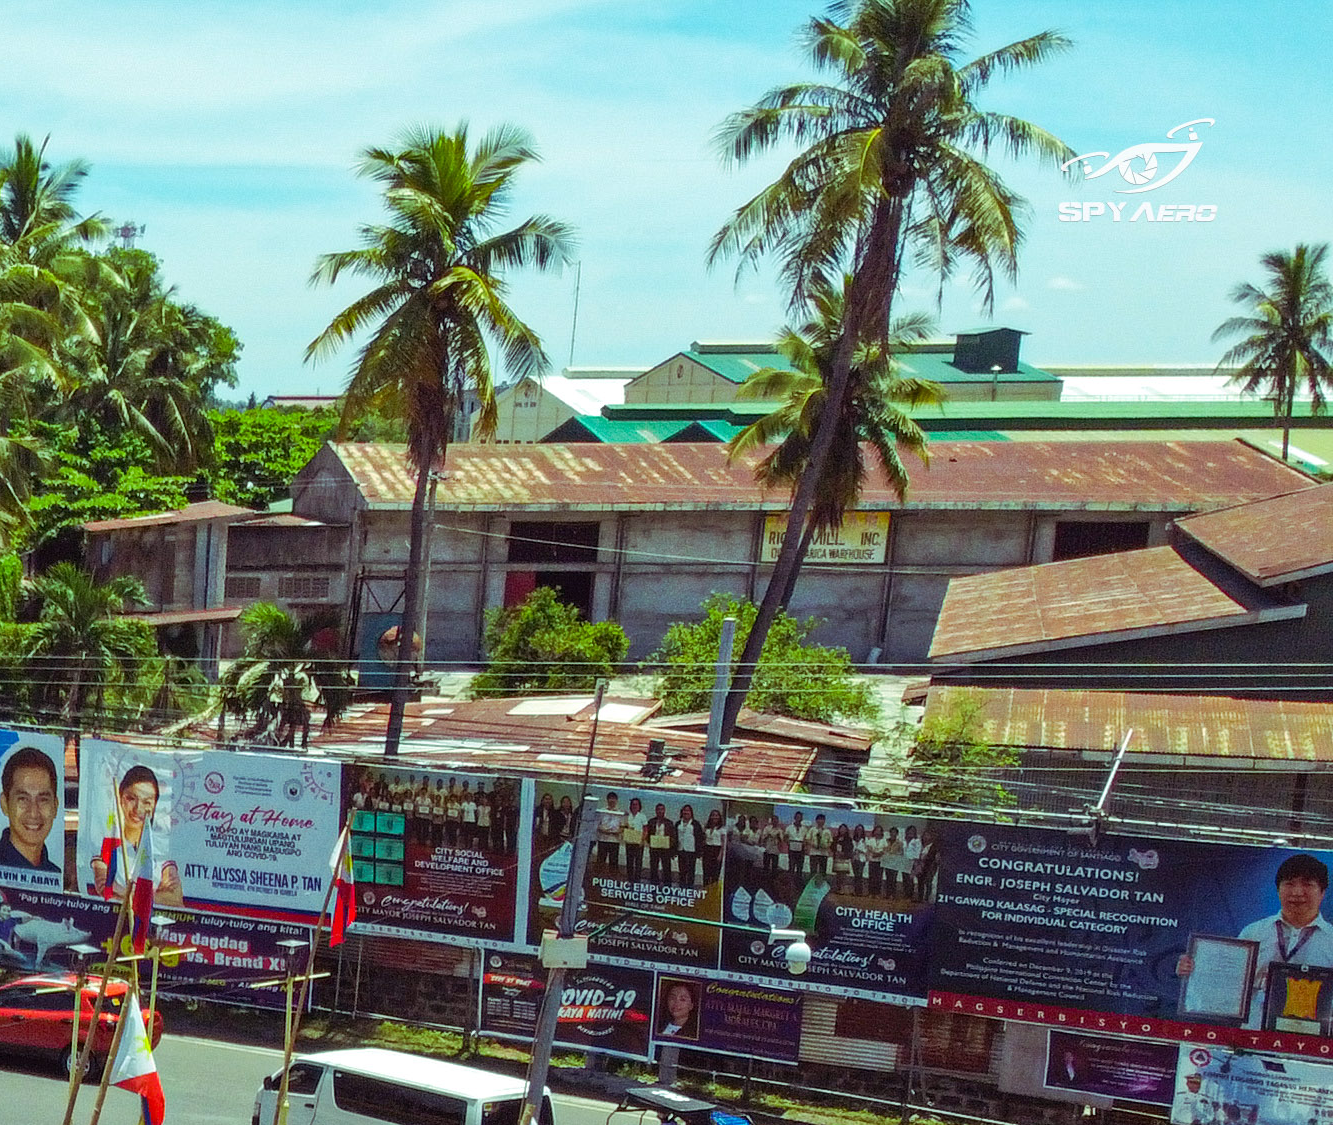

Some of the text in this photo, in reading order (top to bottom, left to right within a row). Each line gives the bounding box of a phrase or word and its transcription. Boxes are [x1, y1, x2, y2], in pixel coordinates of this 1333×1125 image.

[860, 531, 881, 546] INC.
[189, 802, 236, 834] Stay
[239, 805, 261, 825] at
[210, 833, 296, 849] MAGTULUNGAN UPANG
[239, 828, 249, 836] AY
[250, 829, 290, 840] MAGKAISA
[291, 833, 301, 841] AT
[204, 840, 240, 850] TULUYAN
[240, 843, 262, 852] NANG
[226, 849, 243, 858] ANG
[435, 847, 485, 860] CITY SOCIAL
[991, 843, 1122, 862] CITY GOVERNMENT OF SANTIAGO
[414, 860, 504, 877] DEVELOPMENT OFFICE
[430, 855, 489, 867] WELFARE AND
[978, 857, 1139, 883] CONGRATULATIONS!
[19, 873, 30, 883] N.
[30, 875, 60, 887] ABAYA
[184, 863, 322, 892] ATTY. ALYSSA SHEENA P. TAN
[591, 877, 708, 900] PUBLIC EMPLOYMENT
[600, 888, 696, 908] SERVICES OFFICE
[955, 873, 1165, 903] ENGR. JOSEPH SALVADOR TAN
[40, 896, 91, 911] tuluy-tuloy
[93, 903, 111, 914] ang
[1033, 893, 1080, 905] City Mayor
[372, 908, 401, 919] MAYOR
[402, 913, 432, 923] JOSEPH
[432, 915, 477, 928] SALVADOR
[478, 921, 496, 931] TAN
[835, 906, 913, 924] CITY HEALTH
[955, 895, 995, 909] GAWAD
[996, 900, 1046, 914] KALASAG
[1053, 906, 1097, 919] SPECIAL
[1099, 911, 1179, 928] RECOGNITION
[200, 915, 303, 936] tuluy-tuloy ang kita!
[851, 917, 895, 932] OFFICE
[981, 910, 1128, 935] FOR INDIVIDUAL CATEGORY
[156, 927, 249, 953] May dagdag
[597, 937, 629, 949] JOSEPH
[631, 941, 678, 956] SALVADOR
[680, 949, 699, 957] TAN
[186, 952, 286, 972] vs. Brand X!
[738, 955, 907, 985] CITY MAYO SALVADOR TAN
[561, 987, 637, 1009] OVID-19
[932, 996, 1330, 1054] MAGSERBISYO PO TAYO
